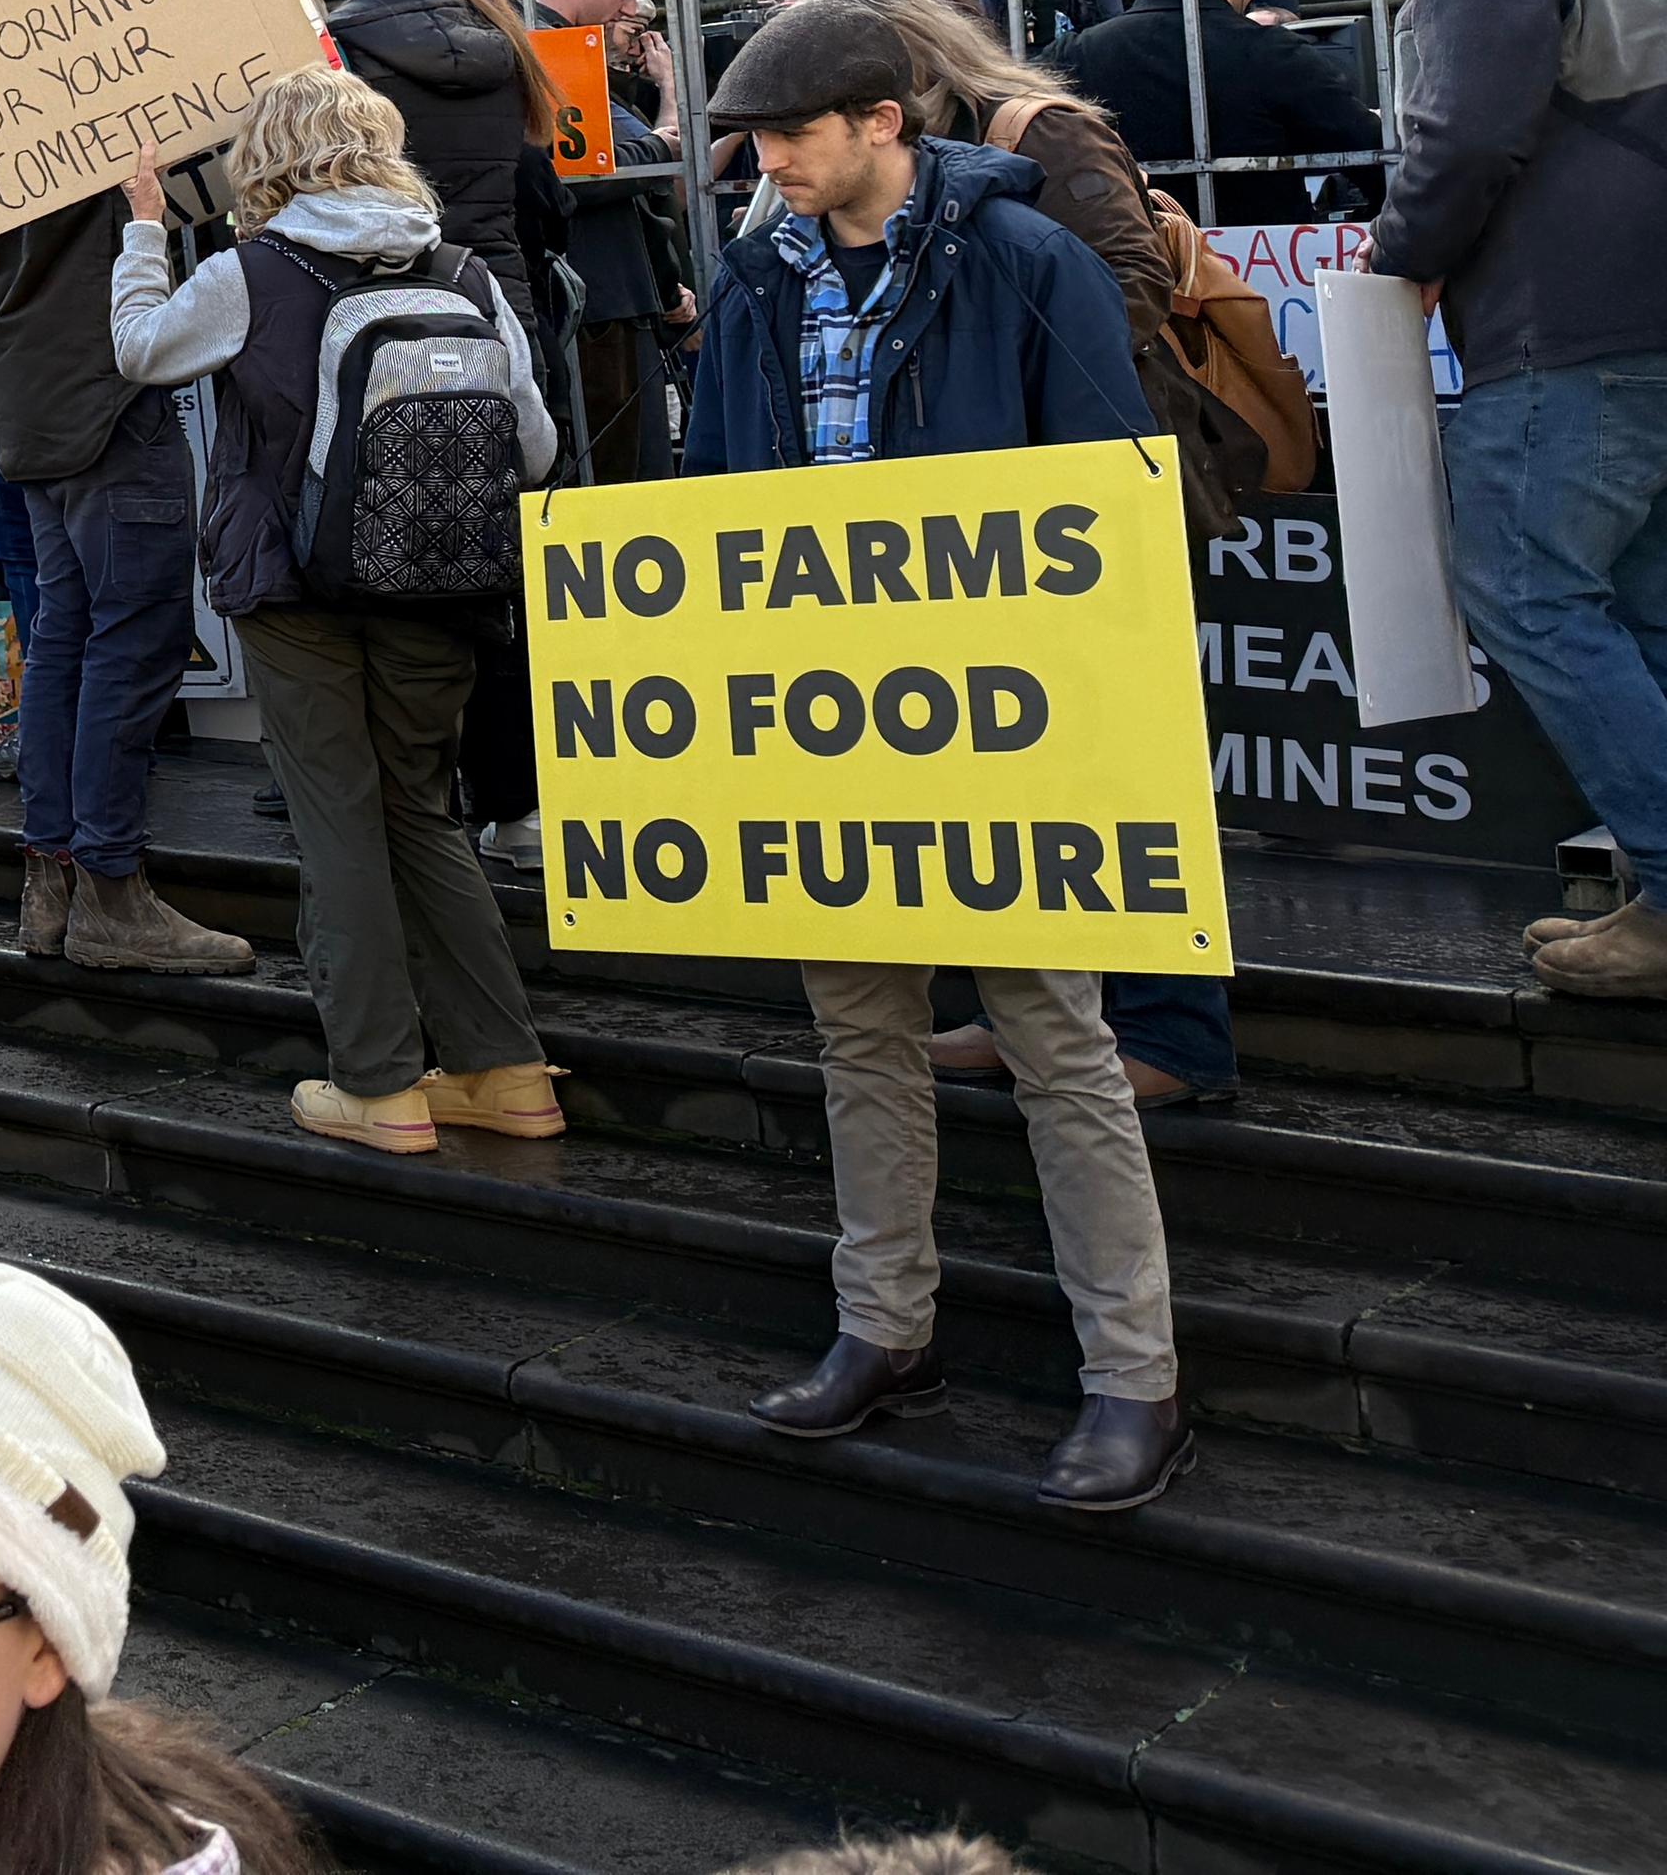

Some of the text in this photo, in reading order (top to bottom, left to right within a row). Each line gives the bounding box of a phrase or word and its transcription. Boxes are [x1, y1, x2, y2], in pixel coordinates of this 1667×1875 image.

[38, 25, 175, 109] YOUR
[543, 503, 1103, 621] NO FARMS
[551, 664, 1049, 759] NO FOOD
[1213, 732, 1473, 822] MINES
[561, 817, 1189, 916] NO FUTURE
